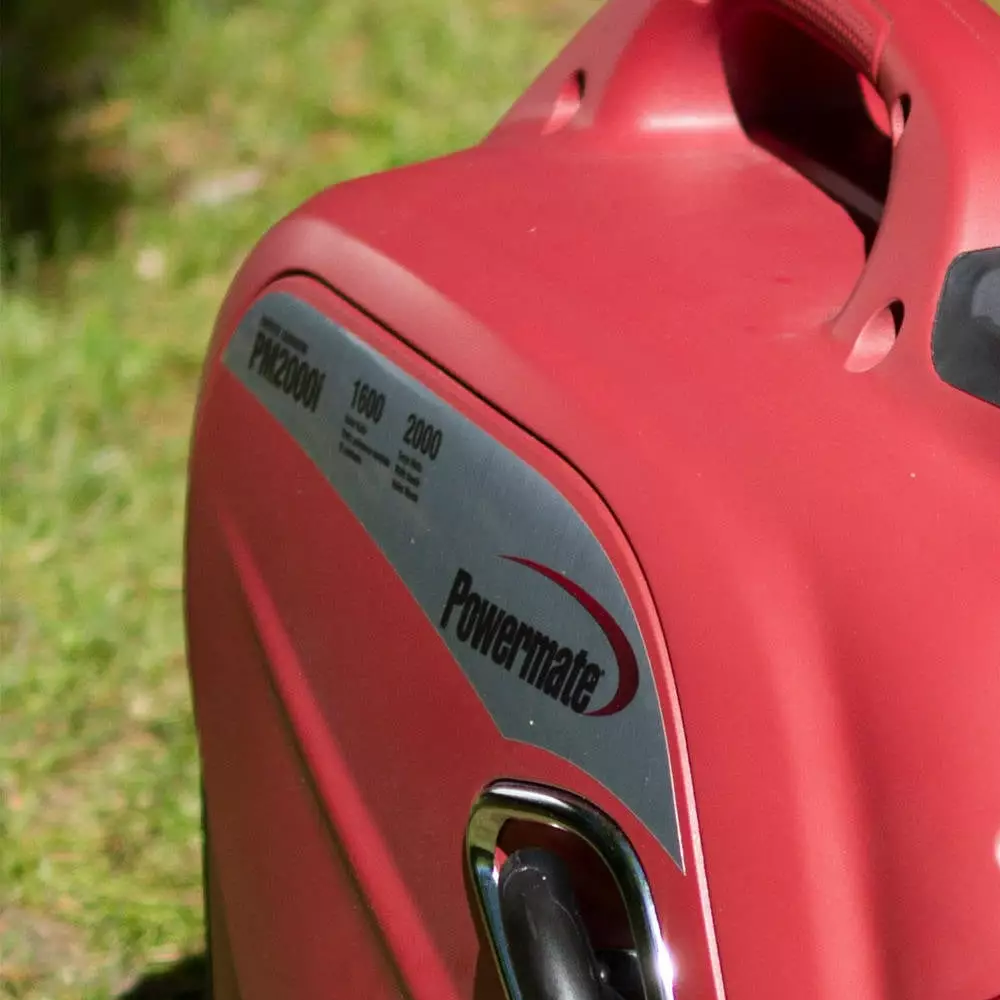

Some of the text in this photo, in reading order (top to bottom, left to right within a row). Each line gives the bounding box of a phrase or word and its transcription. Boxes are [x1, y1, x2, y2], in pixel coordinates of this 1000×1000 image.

[351, 380, 386, 424] 1600
[403, 413, 442, 461] 2000
[440, 567, 602, 714] Powermate
